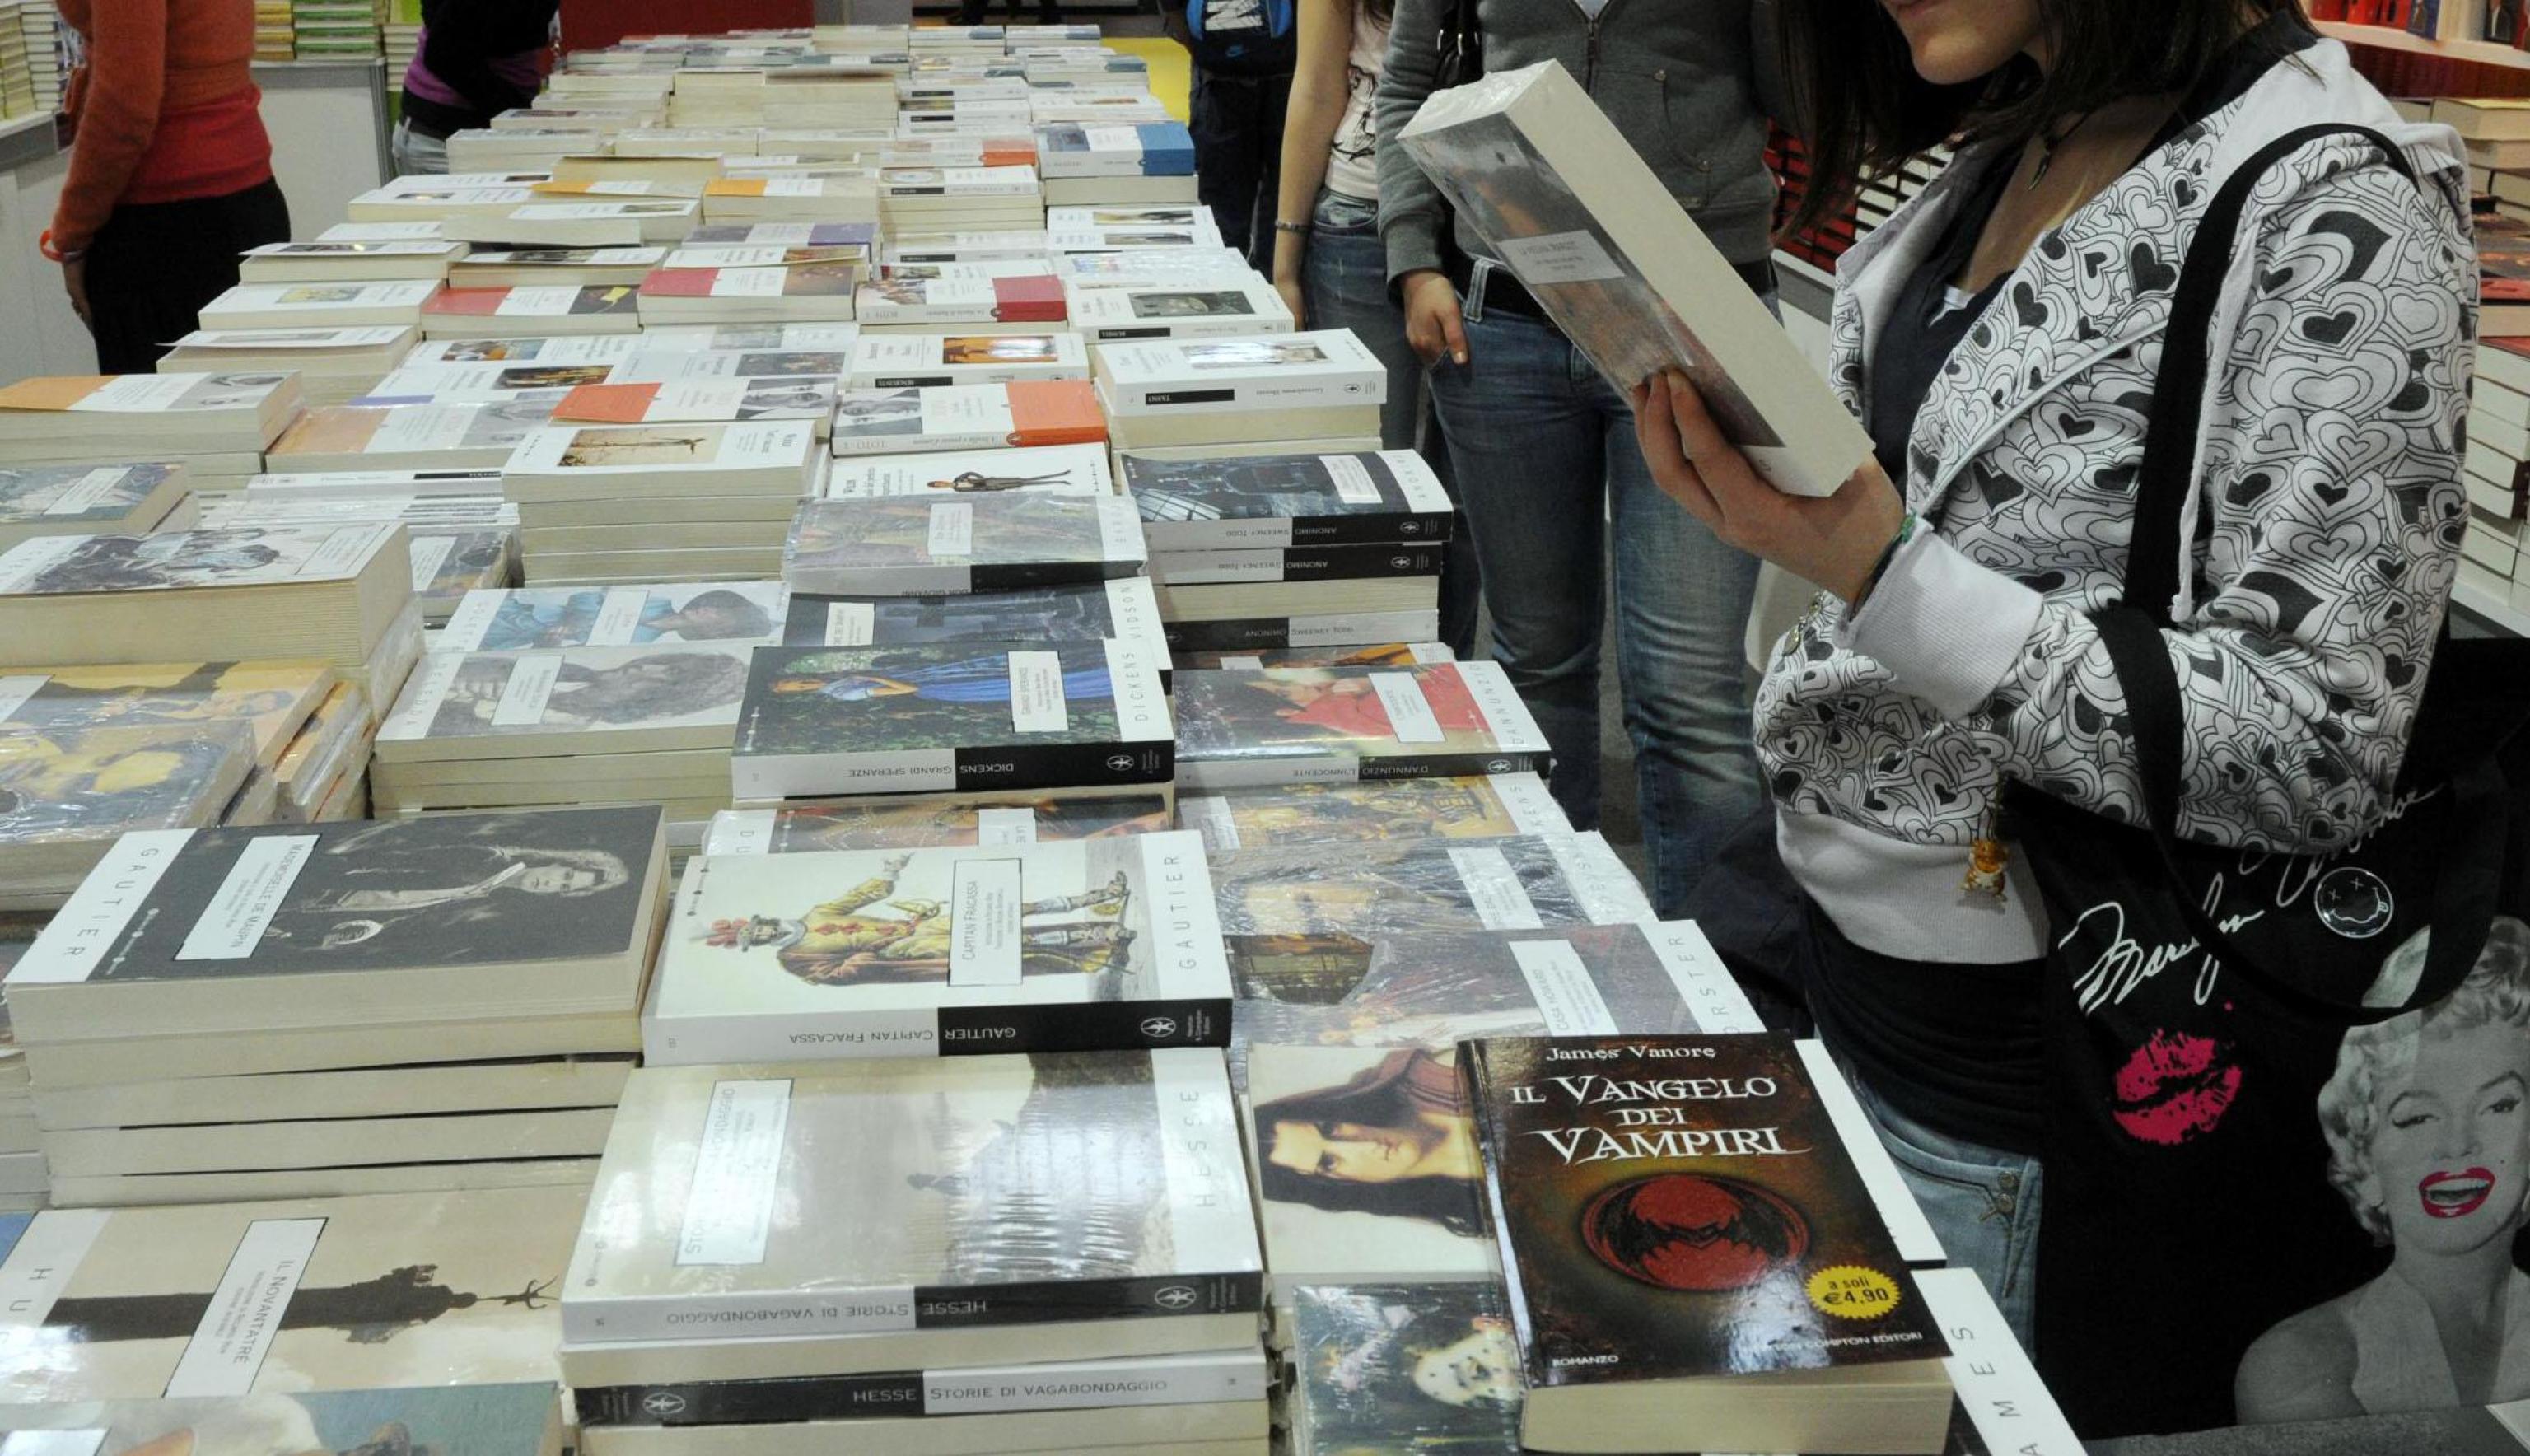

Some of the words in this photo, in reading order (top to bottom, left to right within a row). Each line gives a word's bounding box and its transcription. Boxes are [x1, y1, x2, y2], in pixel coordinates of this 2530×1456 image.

[1122, 651, 1149, 722] DICKENS
[849, 767, 905, 779] SPERANZE
[908, 764, 952, 776] GRANDI
[959, 763, 1015, 774] DICKENS
[63, 847, 159, 957] GAUTIER
[1163, 854, 1198, 969] GAUTIER
[789, 1032, 866, 1045] FRACASSA
[870, 1029, 934, 1043] CAPITAN
[945, 1025, 1016, 1041] GAUTIER
[1546, 1045, 1619, 1062] James
[1627, 1044, 1716, 1061] Vanore
[1510, 1085, 1546, 1104] IL
[1551, 1074, 1779, 1107] VANGELO
[1605, 1106, 1689, 1127] DEI
[1179, 1089, 1217, 1209] HESSE
[1523, 1126, 1813, 1168] VAMPIRI
[278, 1260, 295, 1277] IL
[1828, 1281, 1838, 1290] a
[1842, 1276, 1870, 1289] soli
[821, 1306, 841, 1318] DI
[847, 1303, 910, 1318] STORIE
[920, 1298, 987, 1318] HESSE
[233, 1276, 287, 1365] NOVANTATRE
[666, 1309, 815, 1325] VAGABONDAGGIO
[1873, 1332, 1924, 1345] EDITORI
[1552, 1353, 1620, 1367] ROMANZO
[852, 1388, 917, 1404] HESSE
[930, 1385, 995, 1401] STORIE
[999, 1385, 1018, 1399] DI
[1023, 1379, 1168, 1398] VAGABONDAGGIO
